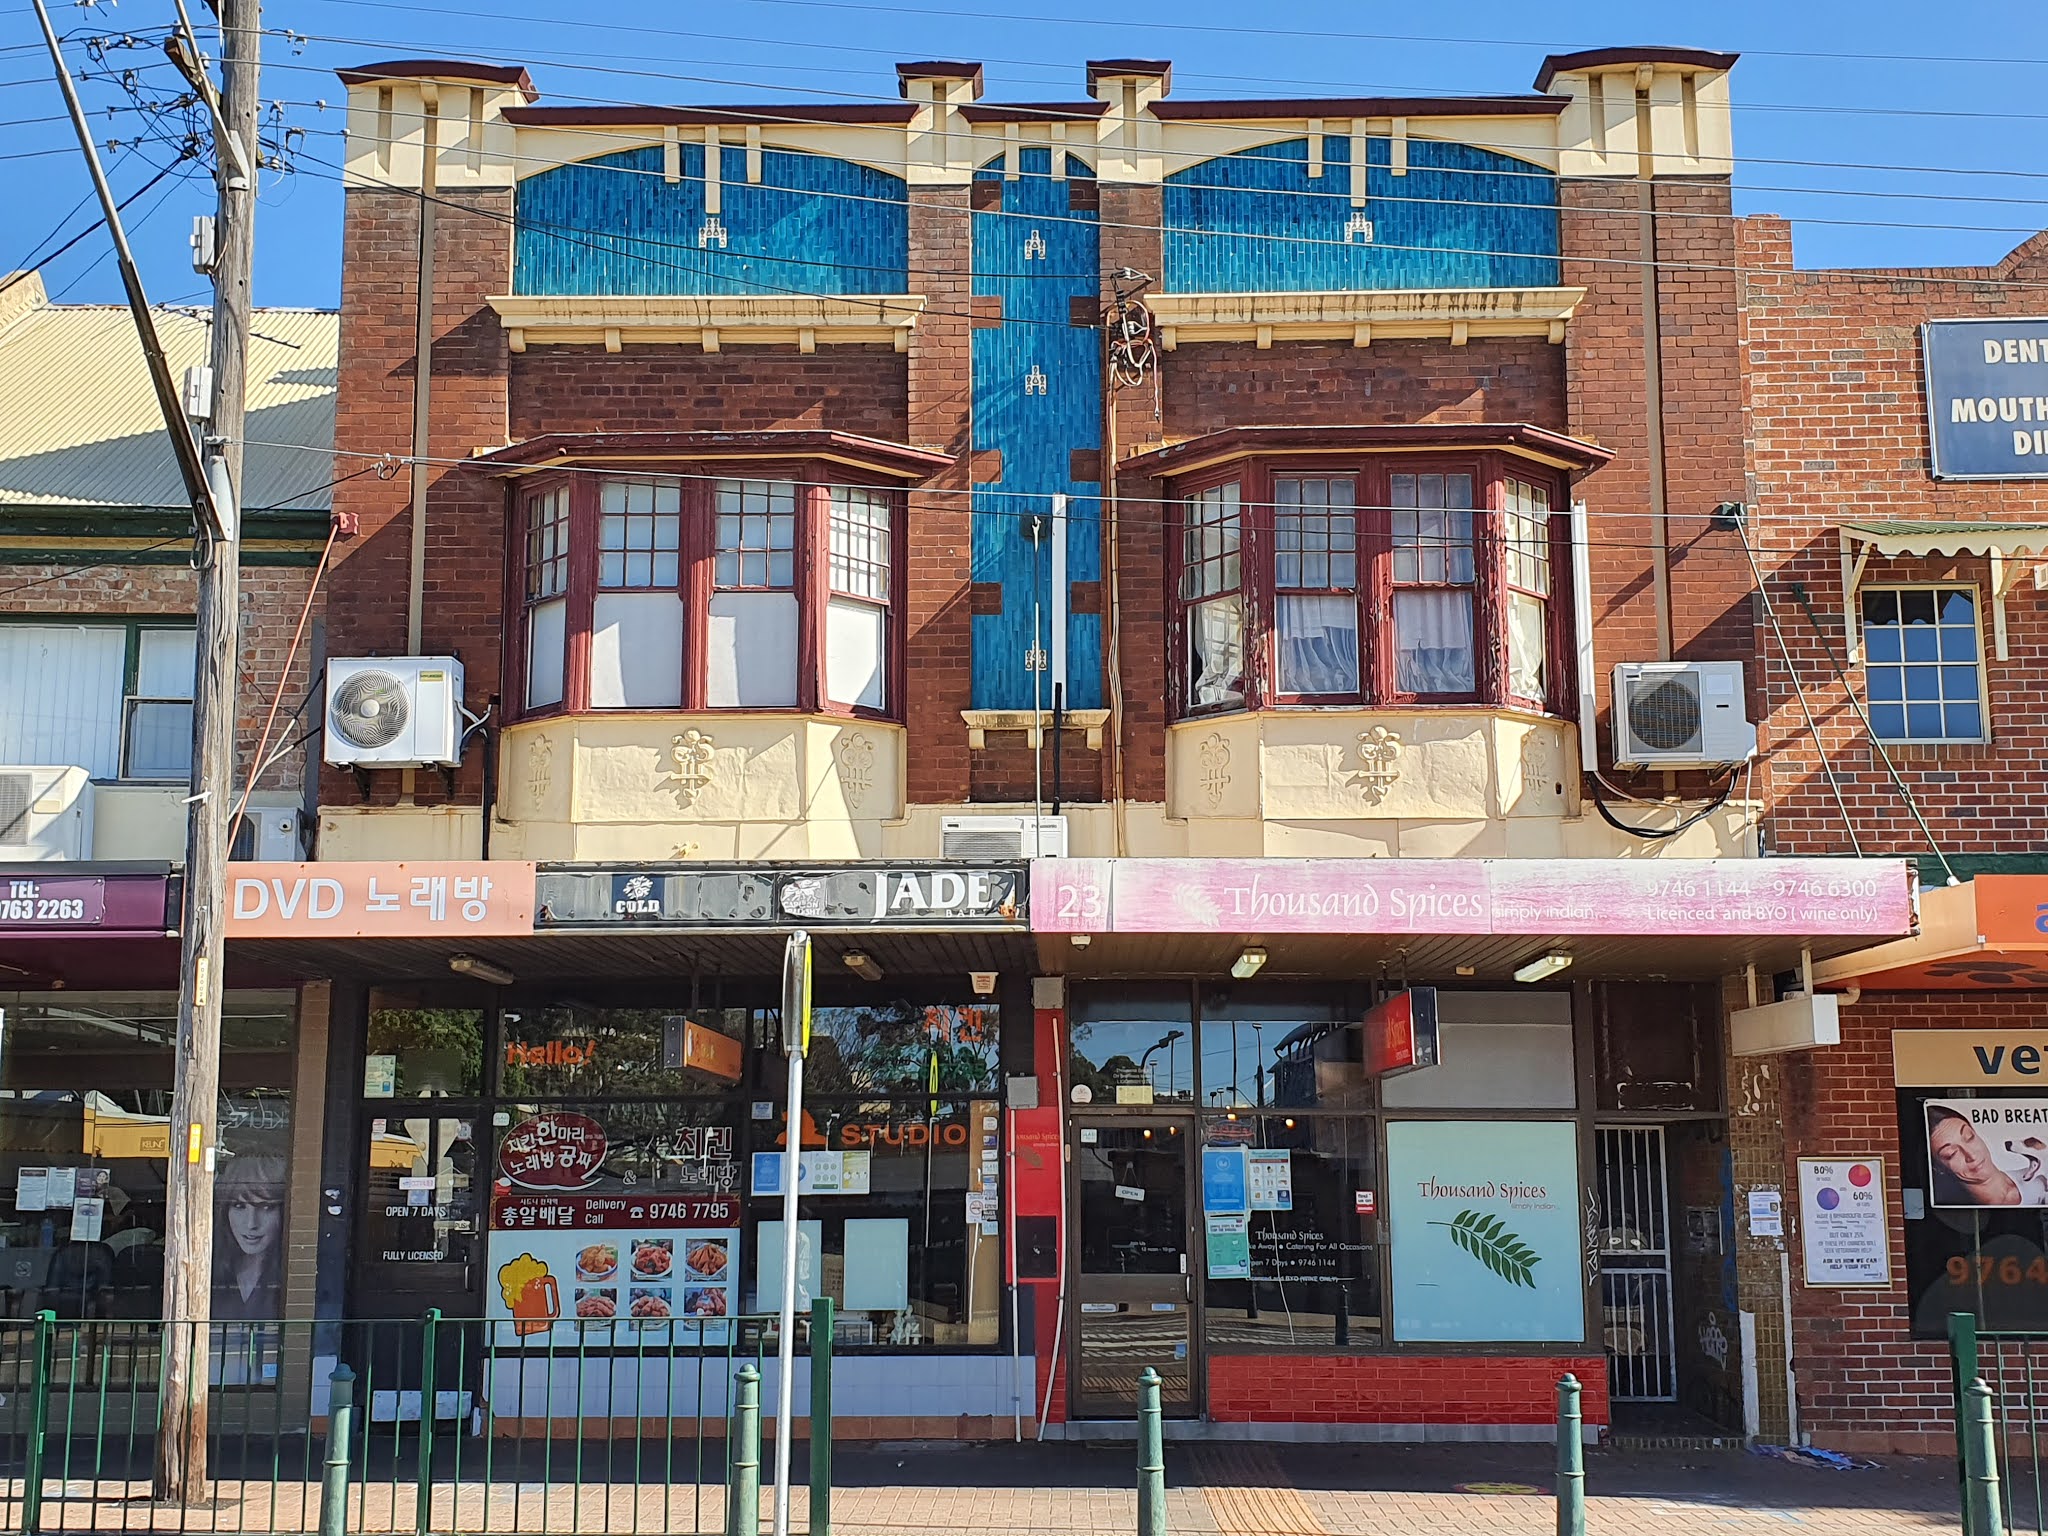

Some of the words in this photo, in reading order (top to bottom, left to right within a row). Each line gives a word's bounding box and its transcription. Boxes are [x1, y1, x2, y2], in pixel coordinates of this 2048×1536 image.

[10, 881, 39, 898] TEL:
[1647, 879, 1695, 897] 9746
[1703, 880, 1749, 896] 1144
[1773, 879, 1822, 896] 9746
[1828, 879, 1877, 896] 6300
[234, 878, 344, 920] DVD
[365, 877, 492, 921] 노래방
[870, 872, 993, 923] JADE
[1057, 885, 1102, 918] 23
[1224, 874, 1379, 921] Thousand
[1390, 884, 1483, 927] Spices
[0, 900, 33, 919] 763
[37, 899, 83, 919] 2263
[615, 899, 660, 914] COLD
[946, 909, 976, 917] BAR
[1495, 904, 1541, 921] simply
[1648, 906, 1715, 920] Licenced
[1723, 906, 1753, 920] and
[1757, 907, 1787, 920] BYO
[1840, 906, 1878, 922] only)
[506, 1039, 597, 1066] Hello!
[1973, 1045, 2048, 1075] ve
[1971, 1108, 1999, 1124] BAD
[840, 1123, 967, 1145] STUDIO
[673, 1126, 732, 1160] 치킨
[510, 1151, 555, 1176] 노래방
[558, 1145, 592, 1170] 공짜
[1813, 1165, 1834, 1175] 80%
[622, 1169, 637, 1185] &
[679, 1165, 737, 1193] 노래방
[1121, 1189, 1139, 1197] OPEN
[1417, 1176, 1495, 1200] Thousand
[1500, 1181, 1546, 1204] Spices
[1853, 1191, 1873, 1201] 60%
[386, 1206, 409, 1217] OPEN
[412, 1207, 419, 1217] 7
[421, 1206, 446, 1217] DAYS
[585, 1199, 627, 1211] Delivery
[649, 1203, 687, 1219] 9746
[692, 1203, 729, 1219] 7795
[501, 1206, 576, 1226] 총알배달
[585, 1213, 604, 1224] Call
[1255, 1227, 1297, 1242] Thousand
[1299, 1230, 1324, 1244] Spices
[1286, 1242, 1314, 1251] Catering
[383, 1250, 406, 1261] FULLY
[407, 1250, 444, 1261] LICENSED
[1271, 1259, 1288, 1268] Days
[1946, 1256, 2048, 1286] 9764
